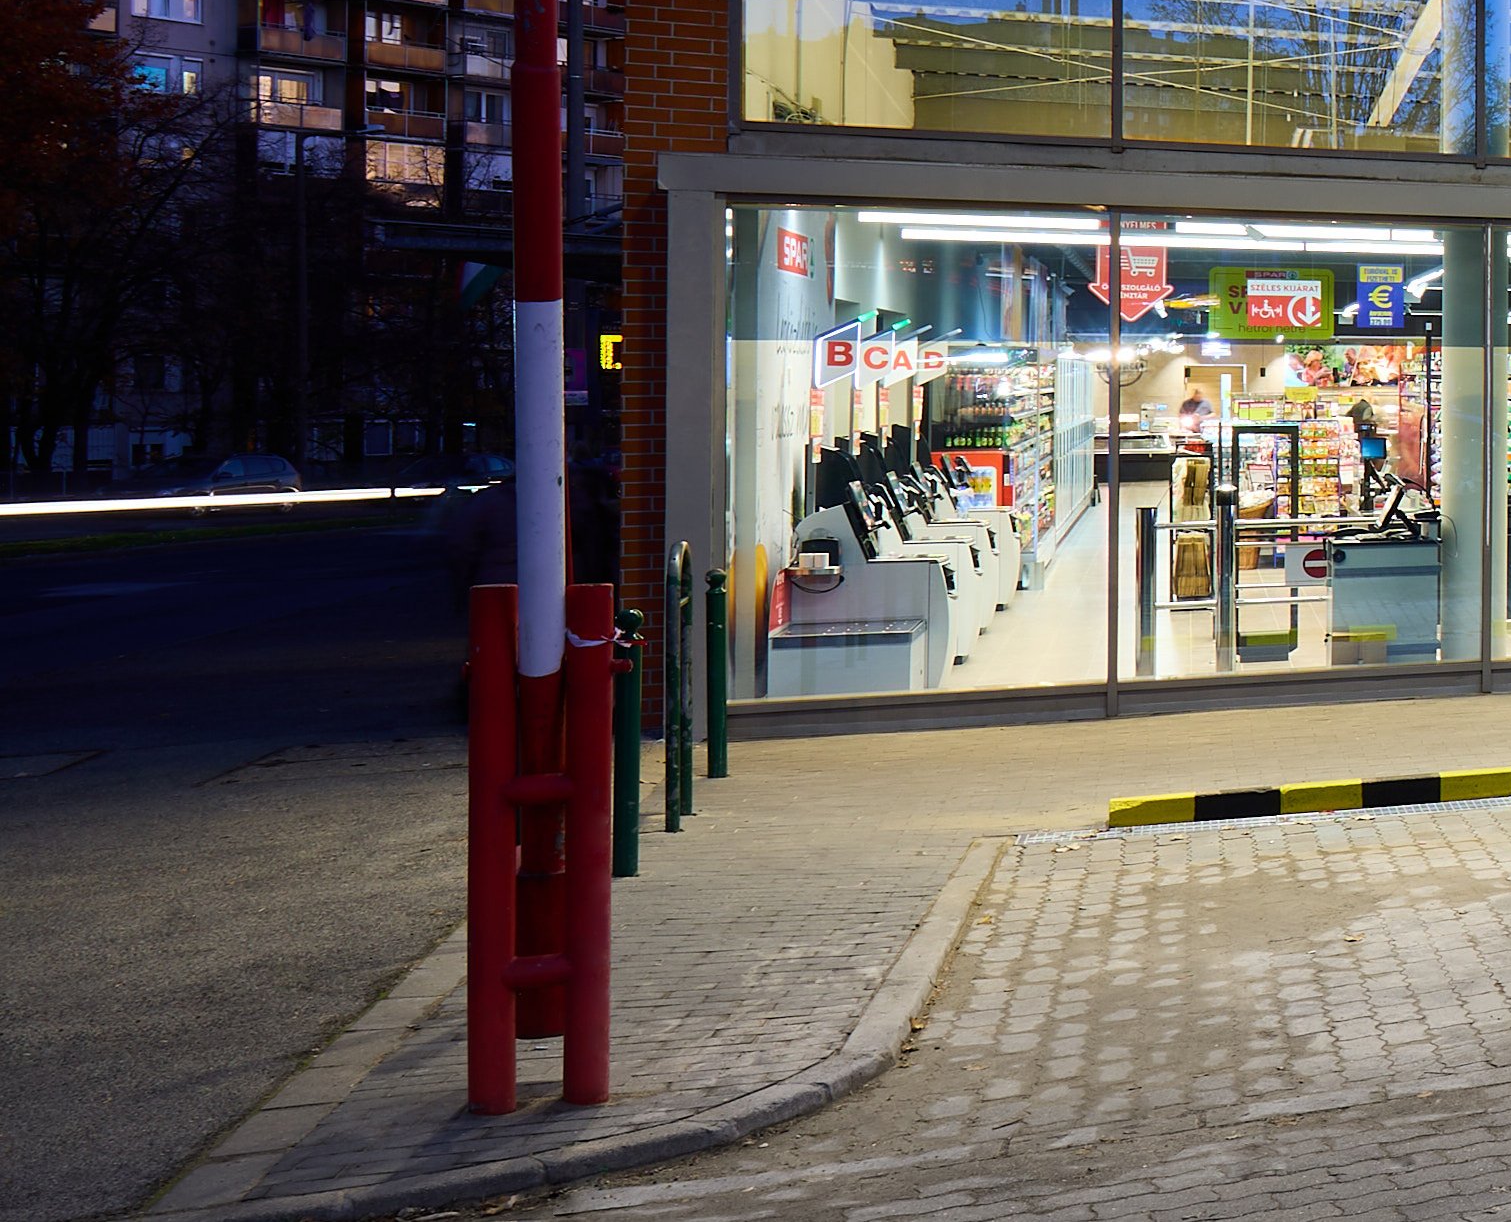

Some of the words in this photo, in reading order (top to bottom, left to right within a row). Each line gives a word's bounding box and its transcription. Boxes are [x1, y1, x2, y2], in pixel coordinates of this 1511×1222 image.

[784, 235, 808, 269] SPAR
[1250, 283, 1281, 291] SZÉLES
[1283, 283, 1319, 292] KIJÁRAT
[827, 341, 853, 366] B
[863, 346, 889, 369] C
[892, 350, 913, 370] A
[924, 351, 944, 369] D
